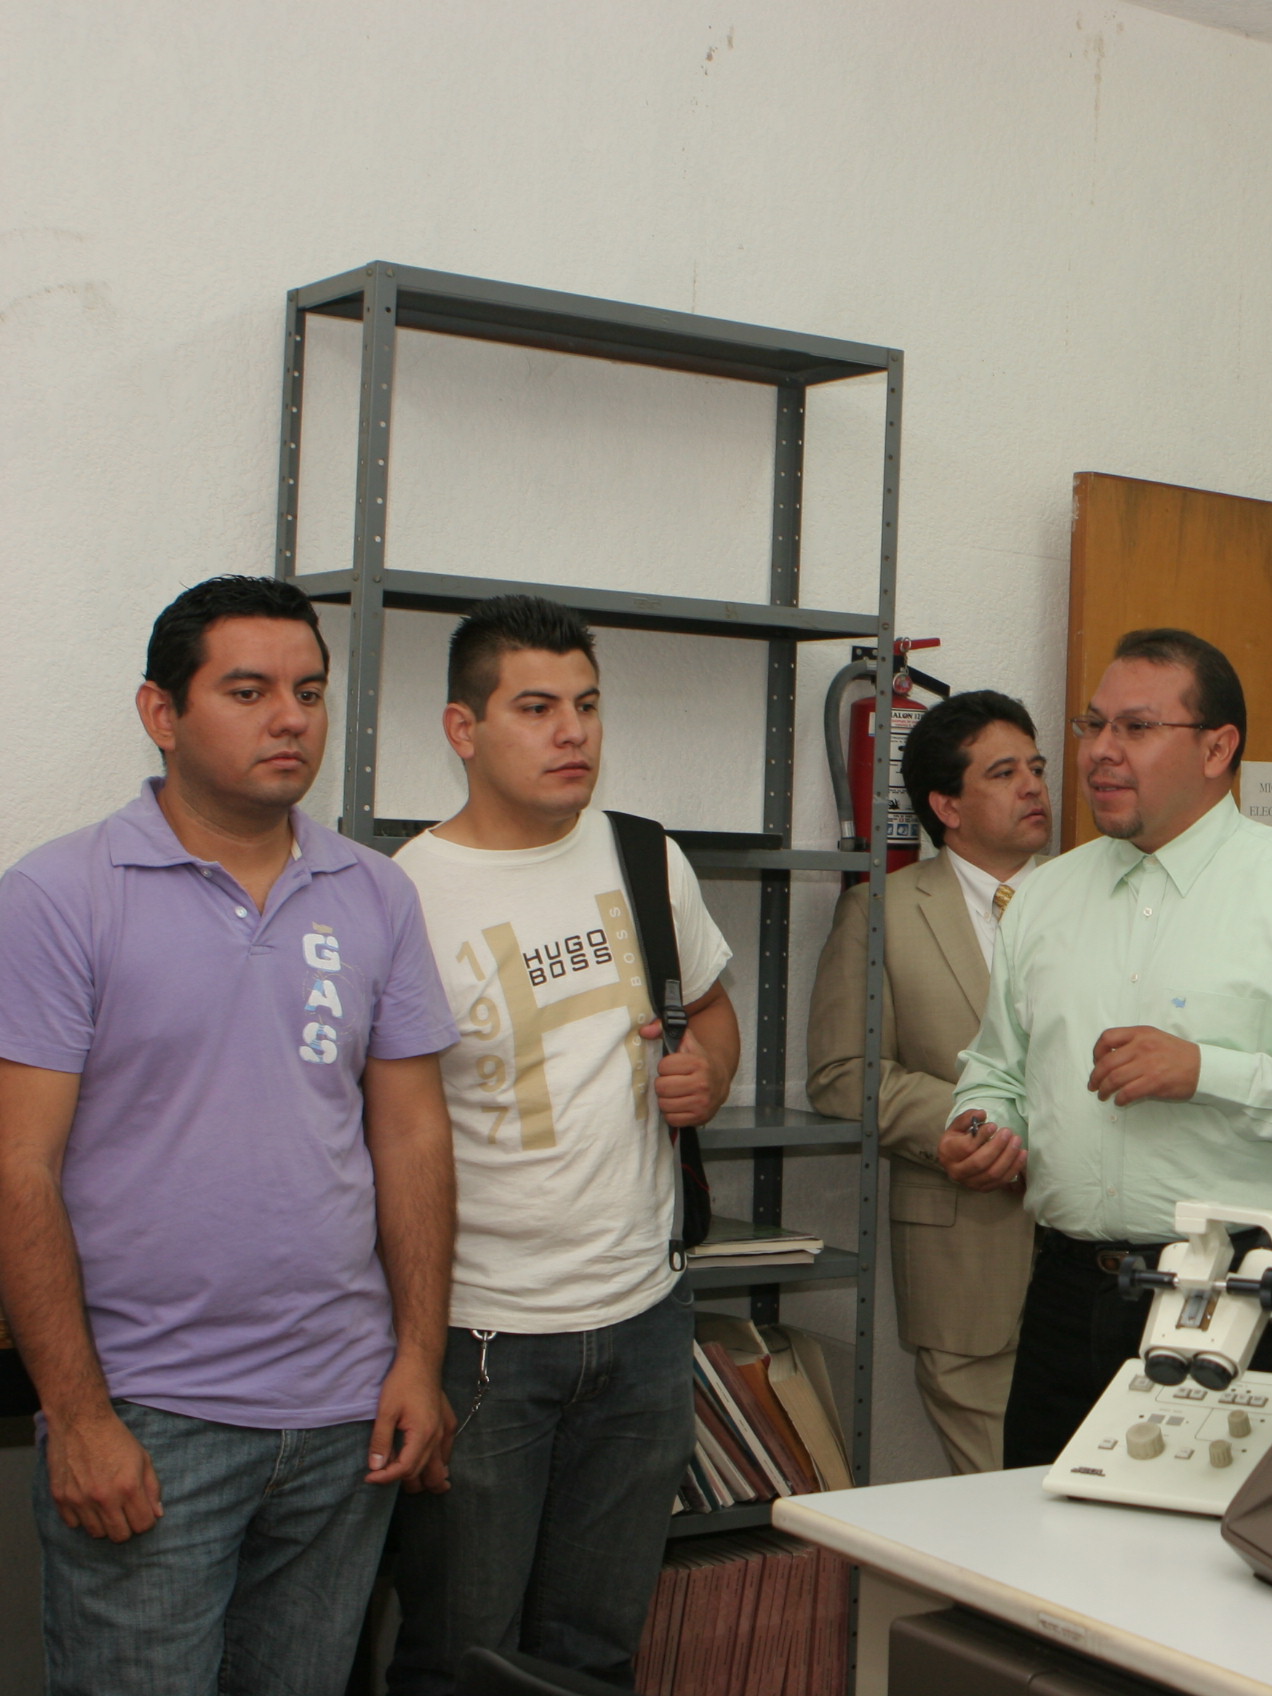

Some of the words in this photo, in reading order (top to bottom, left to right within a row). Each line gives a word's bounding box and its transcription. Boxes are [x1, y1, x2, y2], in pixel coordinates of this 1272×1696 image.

[522, 928, 607, 969] HUGO
[528, 946, 612, 986] BOSS
[300, 934, 342, 1064] GAS
